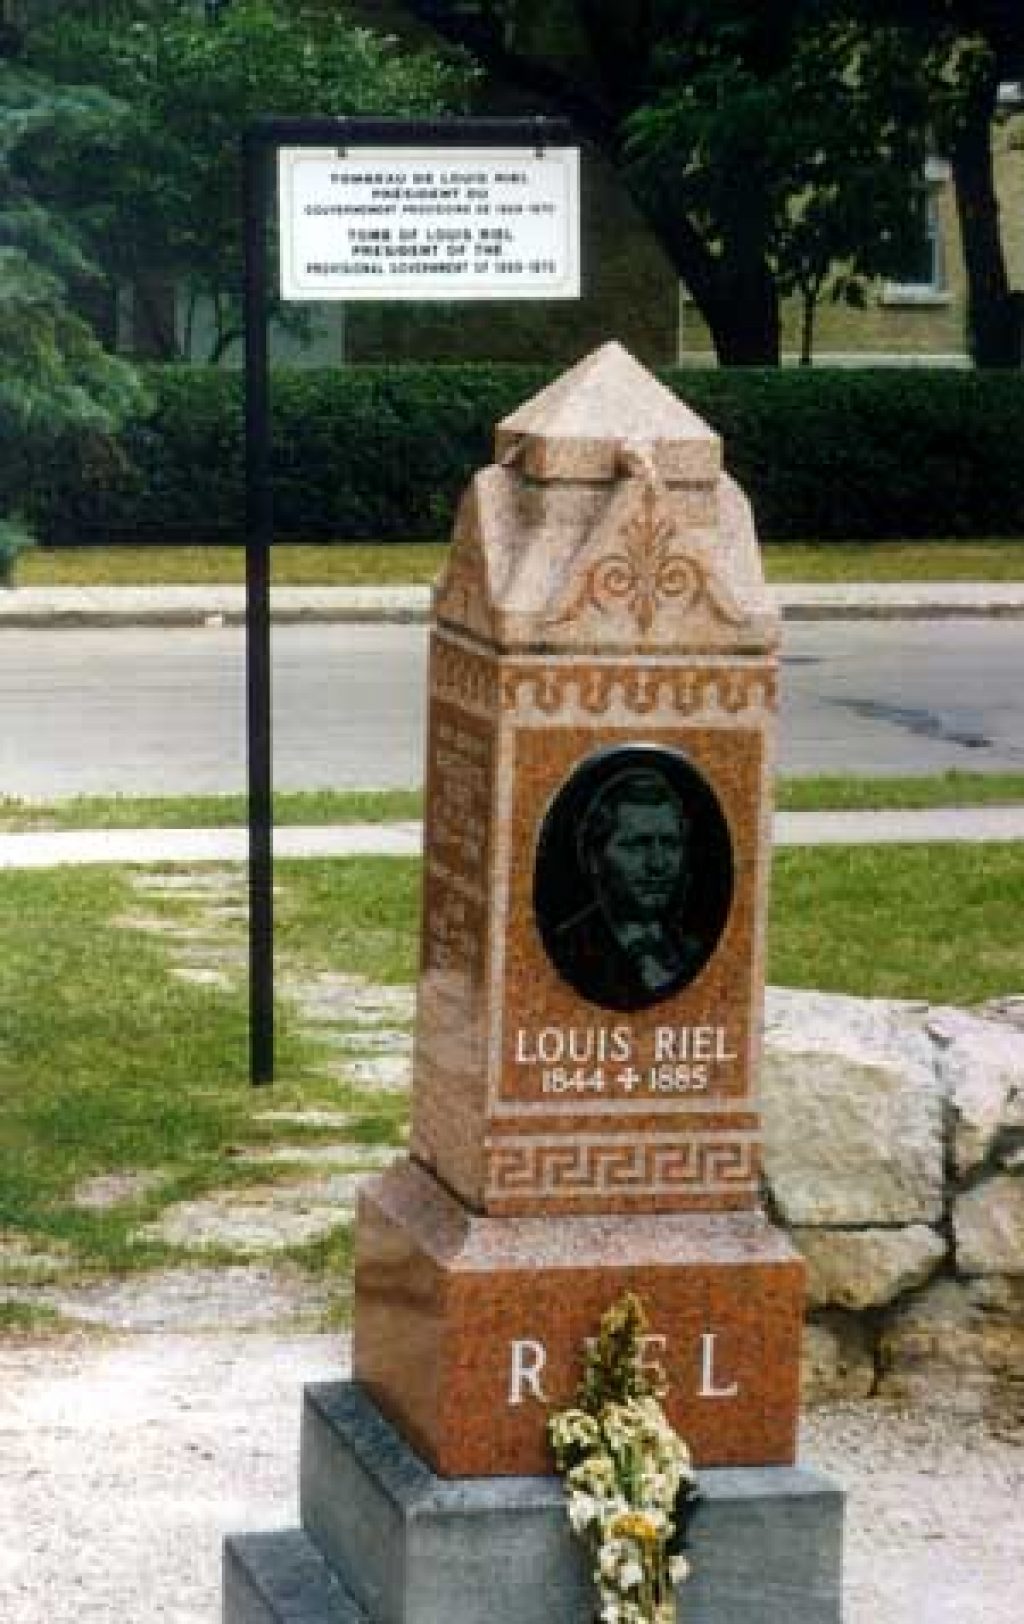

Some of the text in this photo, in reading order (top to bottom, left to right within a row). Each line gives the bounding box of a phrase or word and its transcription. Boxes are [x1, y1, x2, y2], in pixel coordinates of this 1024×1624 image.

[412, 172, 434, 185] DE
[440, 172, 489, 185] LOUIS
[398, 228, 417, 242] OF
[426, 228, 472, 242] LOUIS
[478, 228, 514, 242] RIEL
[351, 244, 502, 257] PRESIDENT OF THE
[515, 1026, 738, 1062] LOUIS RIEL
[542, 1064, 709, 1093] 1844 1885
[507, 1332, 739, 1404] REL
